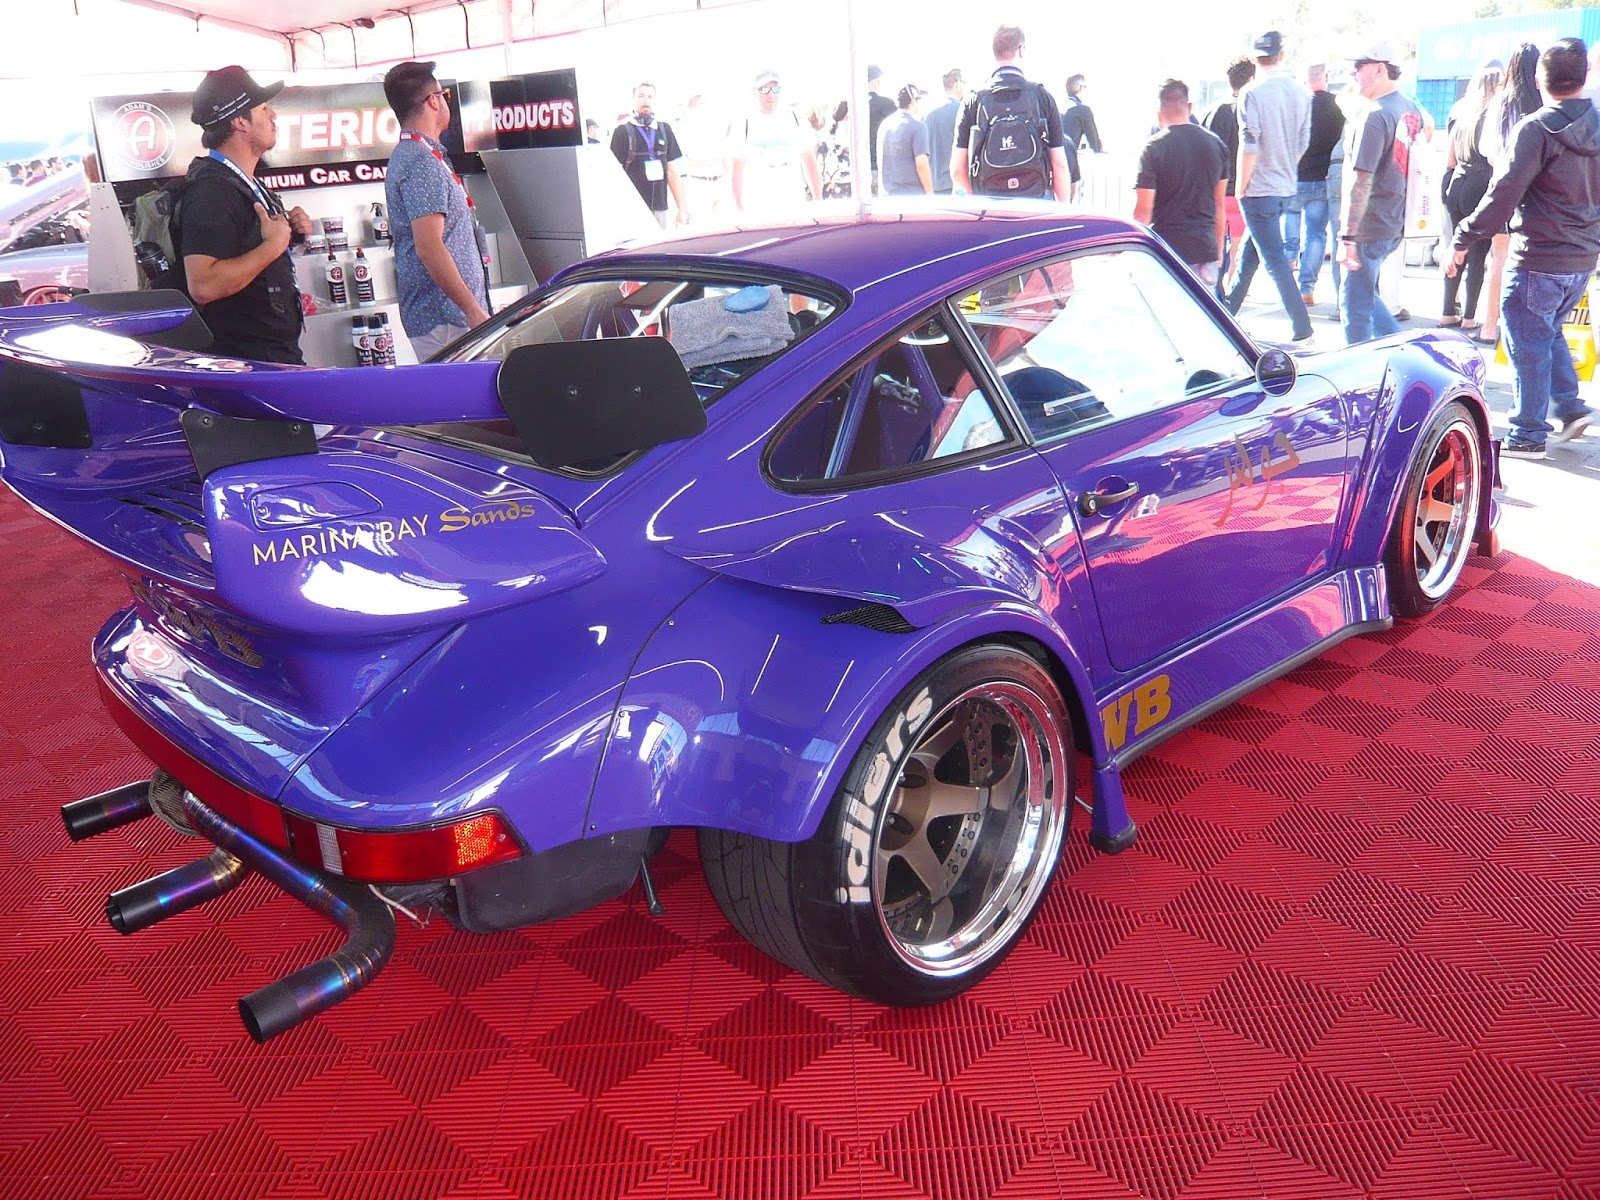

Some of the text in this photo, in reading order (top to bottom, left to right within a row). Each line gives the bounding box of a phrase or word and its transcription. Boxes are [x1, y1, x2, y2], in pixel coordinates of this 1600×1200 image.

[252, 500, 536, 566] MARINA BAY Sands
